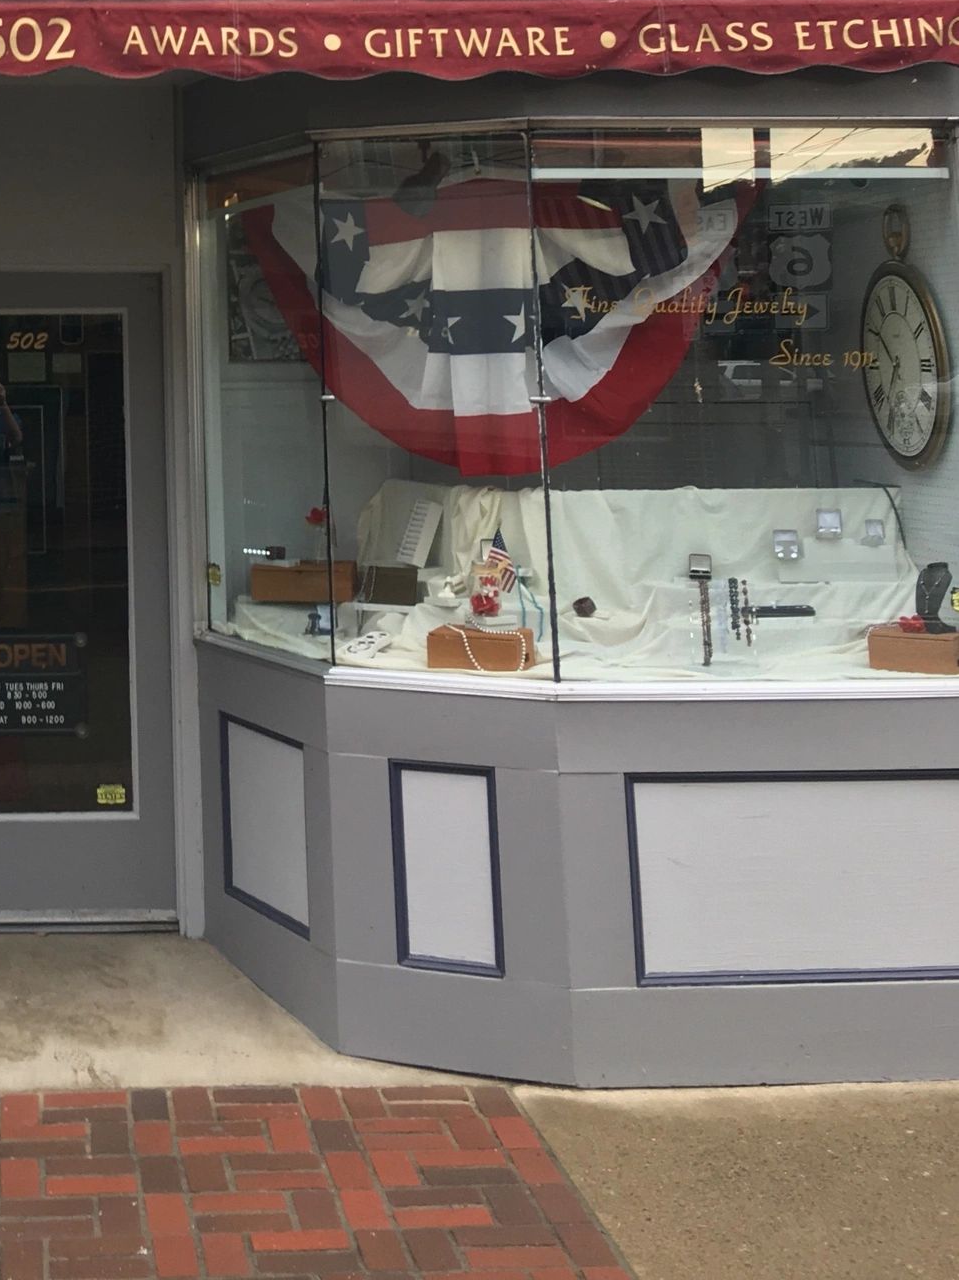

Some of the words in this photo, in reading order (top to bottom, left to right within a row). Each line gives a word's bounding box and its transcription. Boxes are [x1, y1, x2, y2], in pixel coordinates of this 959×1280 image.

[121, 25, 299, 58] AWARDS
[363, 26, 576, 58] GIFTWARE
[638, 22, 774, 54] GLASS
[723, 286, 809, 326] Jewelry
[6, 331, 50, 350] 502
[768, 338, 834, 367] Since
[842, 349, 876, 372] 1911
[51, 681, 65, 691] FRI
